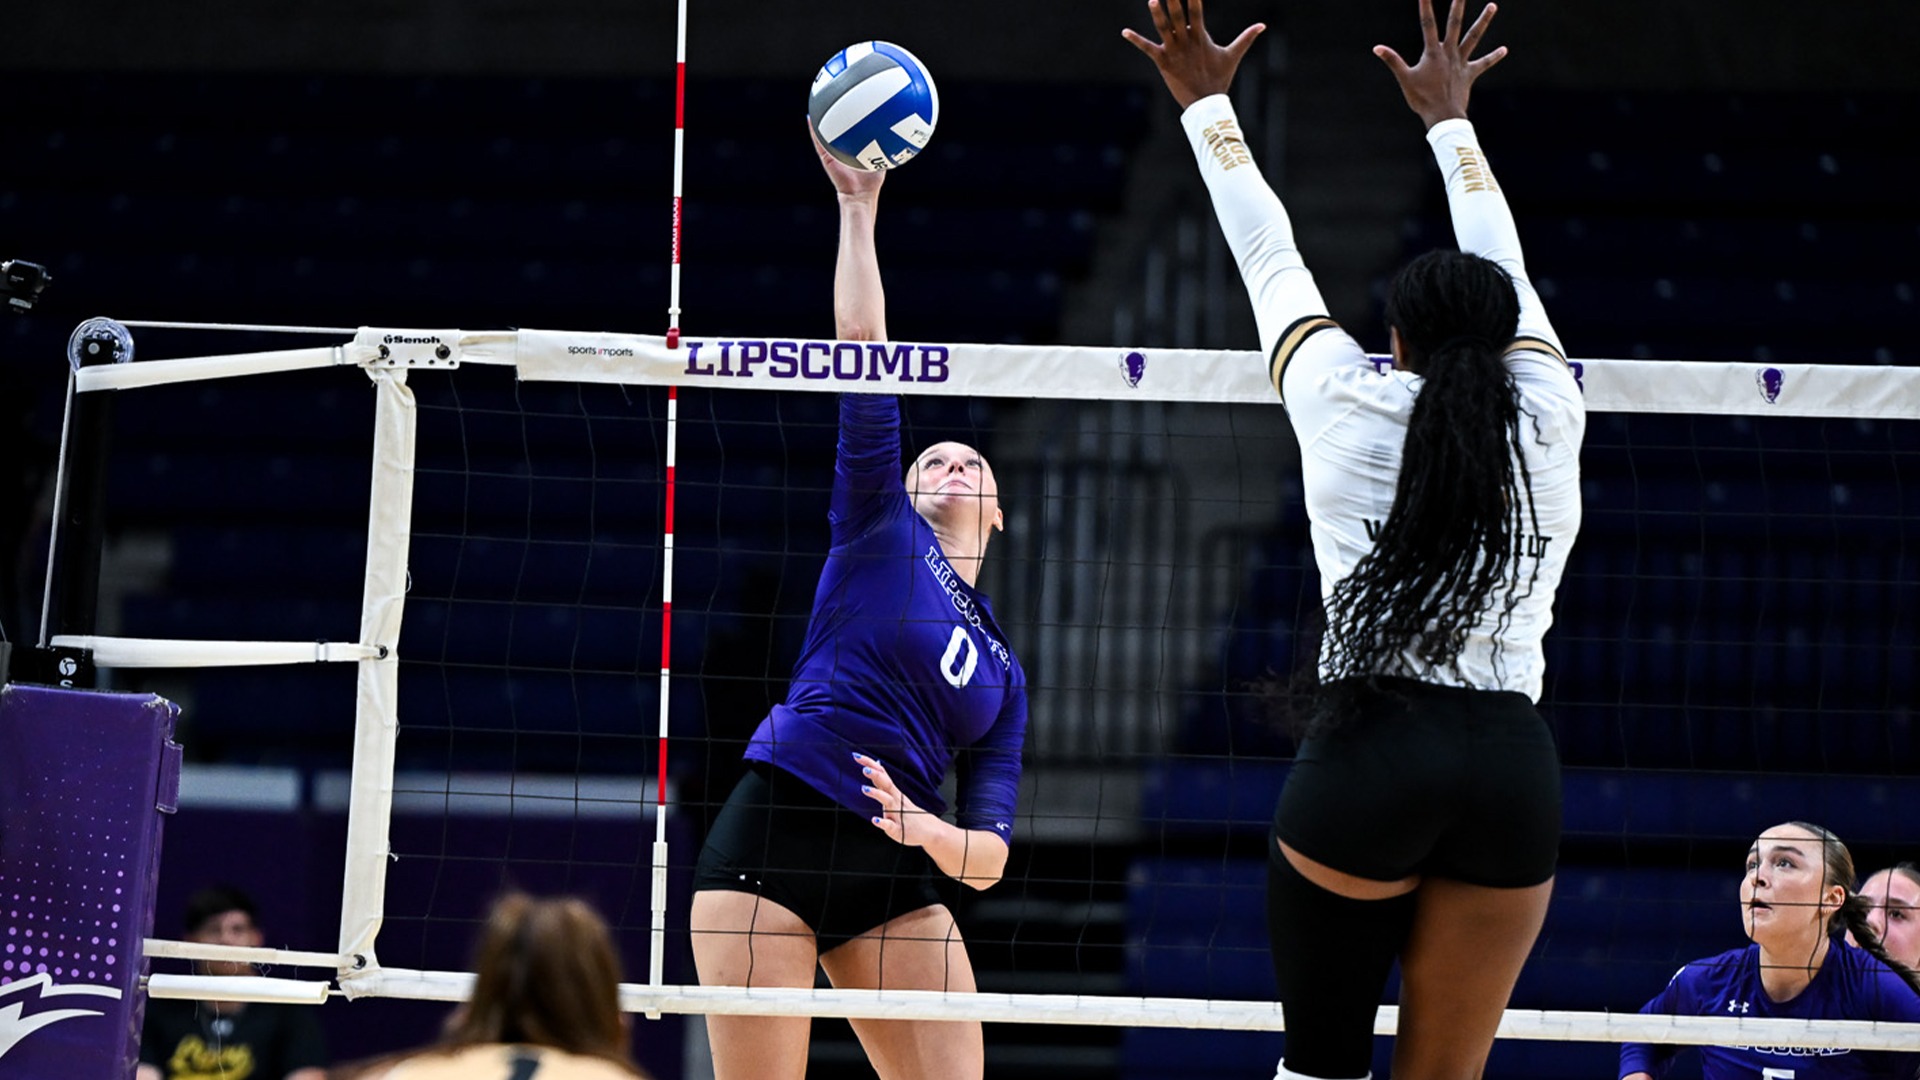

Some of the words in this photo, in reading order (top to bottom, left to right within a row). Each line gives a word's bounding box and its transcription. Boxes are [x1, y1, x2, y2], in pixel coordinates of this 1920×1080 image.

[393, 334, 441, 345] Senoh
[567, 345, 597, 356] sports
[597, 347, 634, 358] imports
[684, 341, 950, 383] LIPSCOMB
[940, 625, 979, 689] 0
